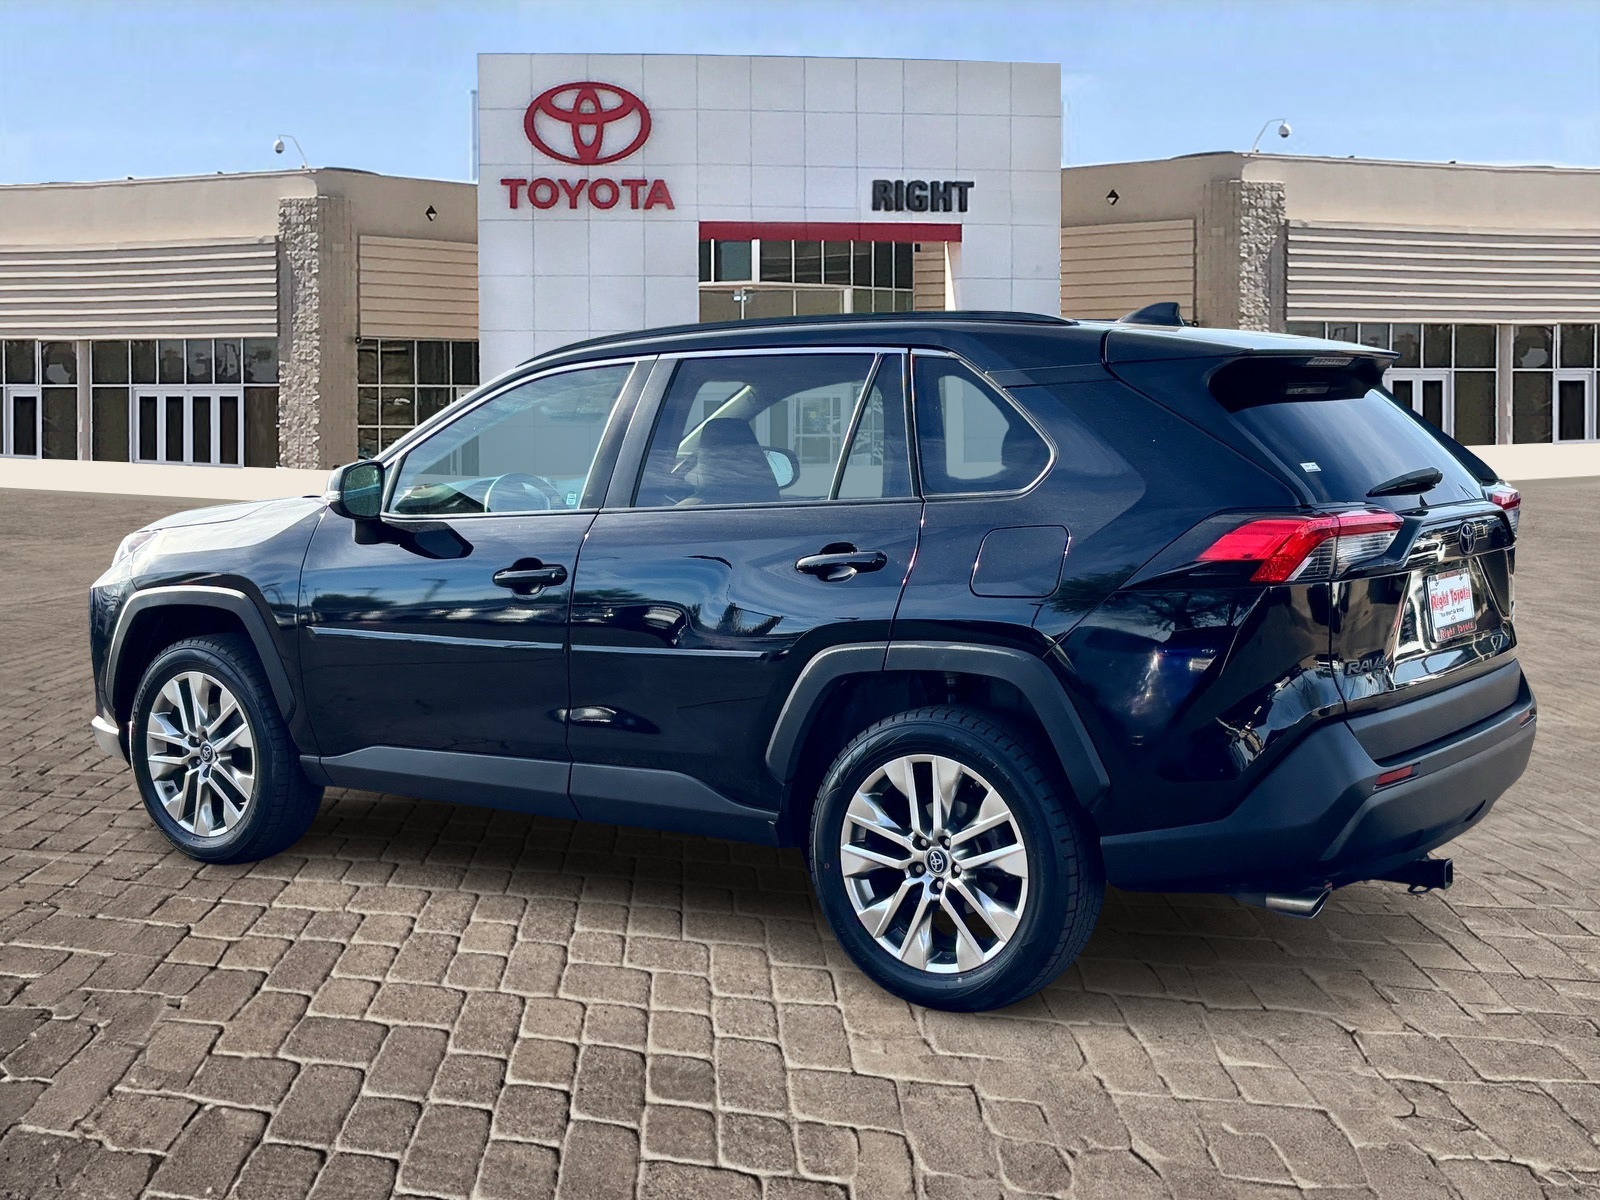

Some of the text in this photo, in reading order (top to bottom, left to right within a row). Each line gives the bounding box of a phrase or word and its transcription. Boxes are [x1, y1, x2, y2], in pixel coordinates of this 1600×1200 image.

[500, 178, 675, 210] TOYOTA
[871, 179, 975, 213] RIGHT
[1431, 586, 1470, 610] Right Toyota
[1346, 655, 1386, 675] RAV4
